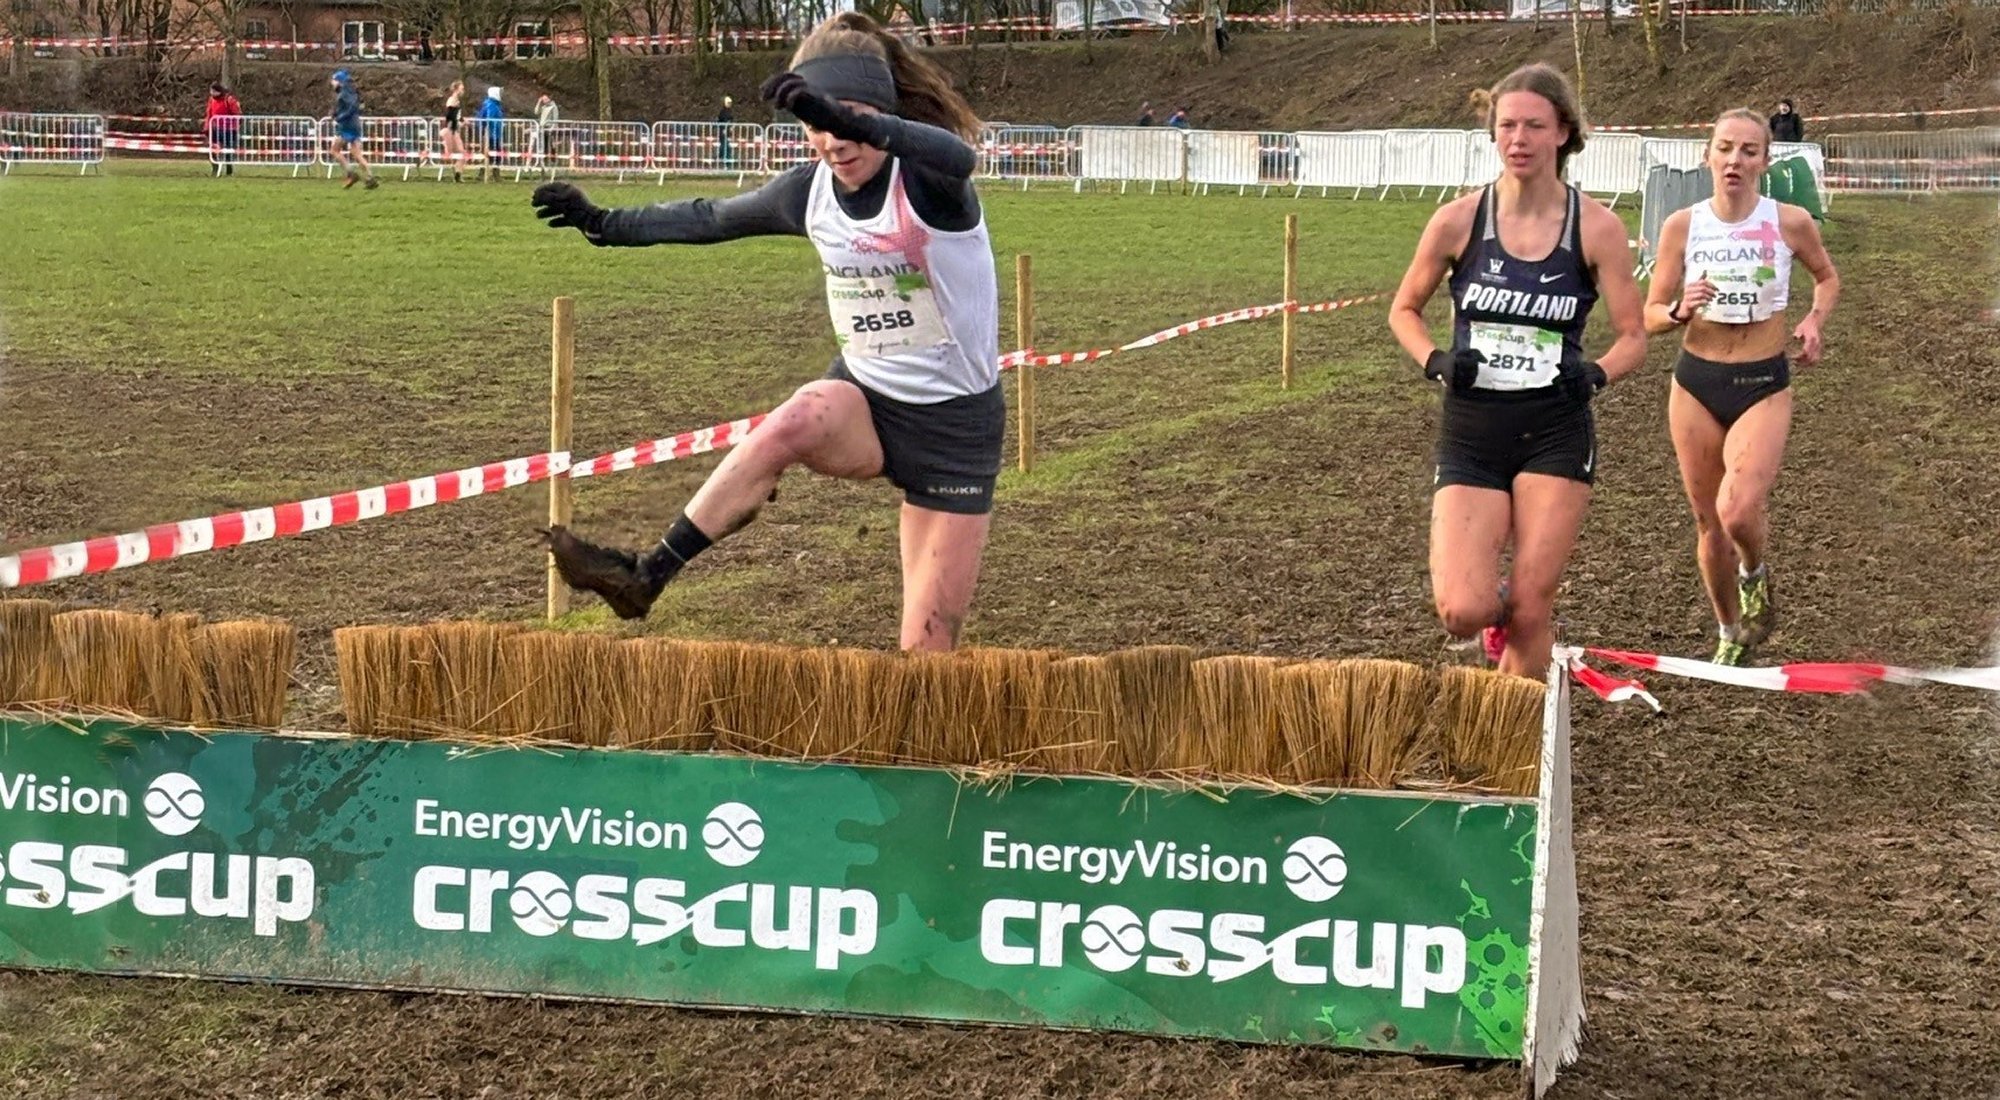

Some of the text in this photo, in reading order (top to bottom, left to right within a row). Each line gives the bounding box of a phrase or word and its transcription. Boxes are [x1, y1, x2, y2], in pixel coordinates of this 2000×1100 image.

[824, 263, 921, 278] NGLAND
[1693, 247, 1776, 263] ENGLAND
[1461, 283, 1578, 321] PORTLAND
[1717, 292, 1759, 305] 2651
[851, 310, 915, 333] 2658
[1488, 353, 1536, 372] 2871
[0, 772, 128, 816] Vision
[415, 799, 688, 851] EnergyVision
[983, 831, 1267, 885] EnergyVision
[0, 841, 315, 937] sscup
[413, 865, 878, 970] crosscup
[980, 898, 1467, 1009] crosscup
